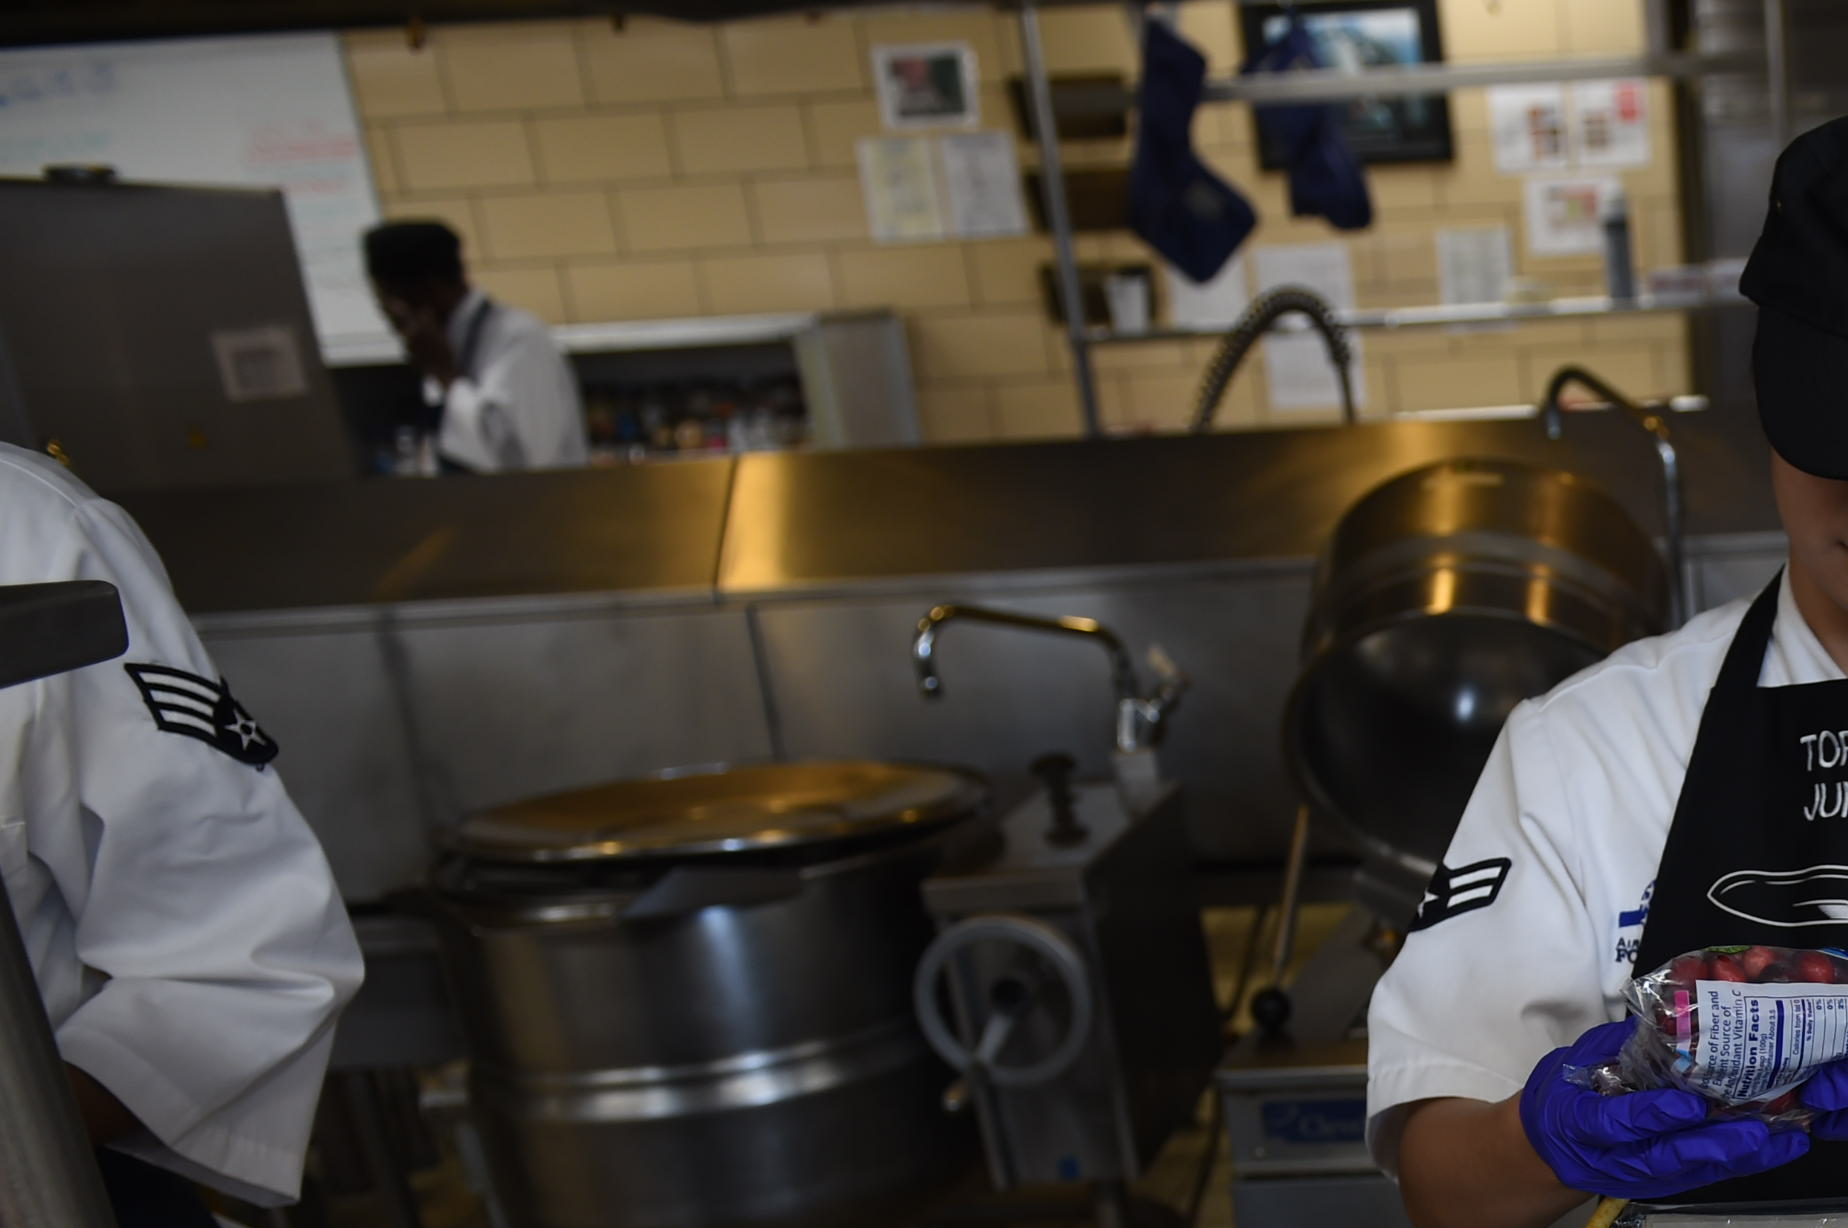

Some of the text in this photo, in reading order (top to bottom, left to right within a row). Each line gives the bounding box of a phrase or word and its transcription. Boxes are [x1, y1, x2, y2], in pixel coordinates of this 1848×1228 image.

[1731, 989, 1741, 997] C
[1707, 990, 1720, 1053] of Fiber and
[1719, 1005, 1731, 1057] Source of
[1732, 999, 1744, 1040] Vitamin
[1737, 1046, 1758, 1098] Nutrition
[1748, 999, 1760, 1042] Facts
